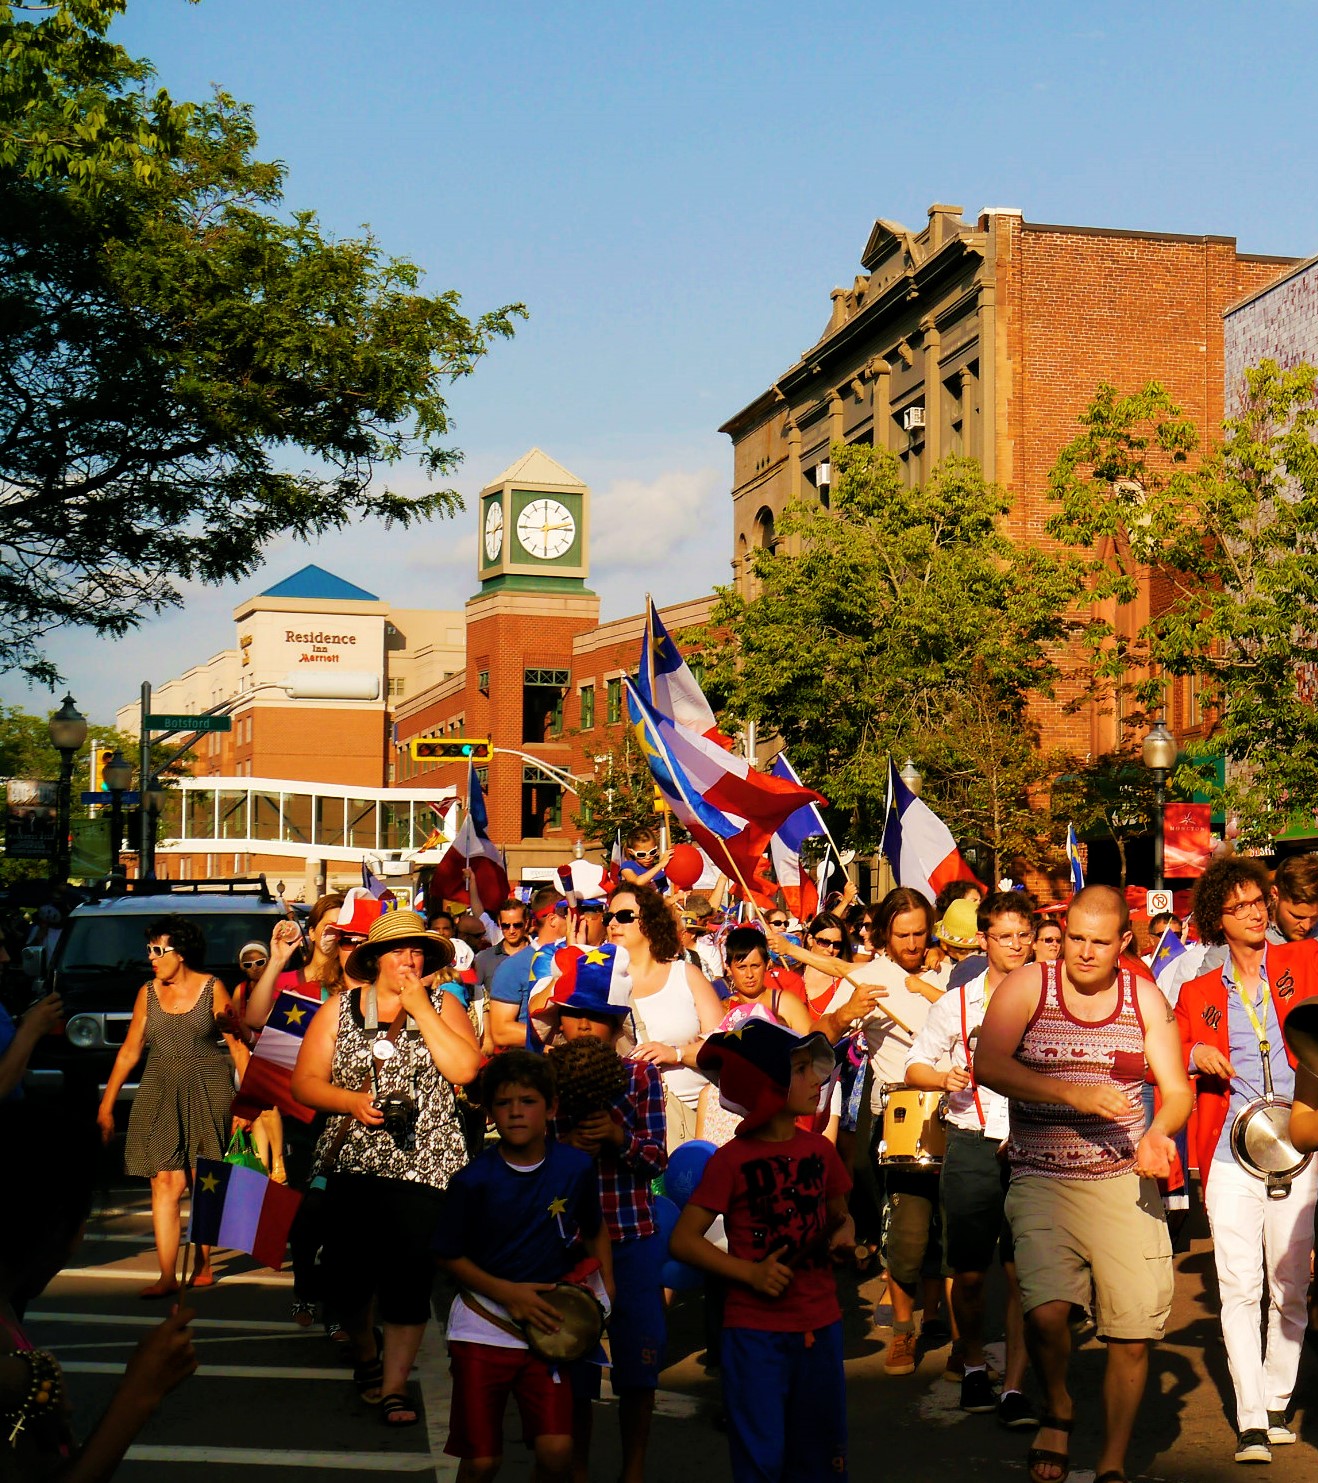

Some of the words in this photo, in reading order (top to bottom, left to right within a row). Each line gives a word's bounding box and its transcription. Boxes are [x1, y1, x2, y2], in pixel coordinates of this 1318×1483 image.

[285, 630, 356, 645] Residence
[299, 653, 339, 662] Marriott
[164, 717, 210, 729] Botsford
